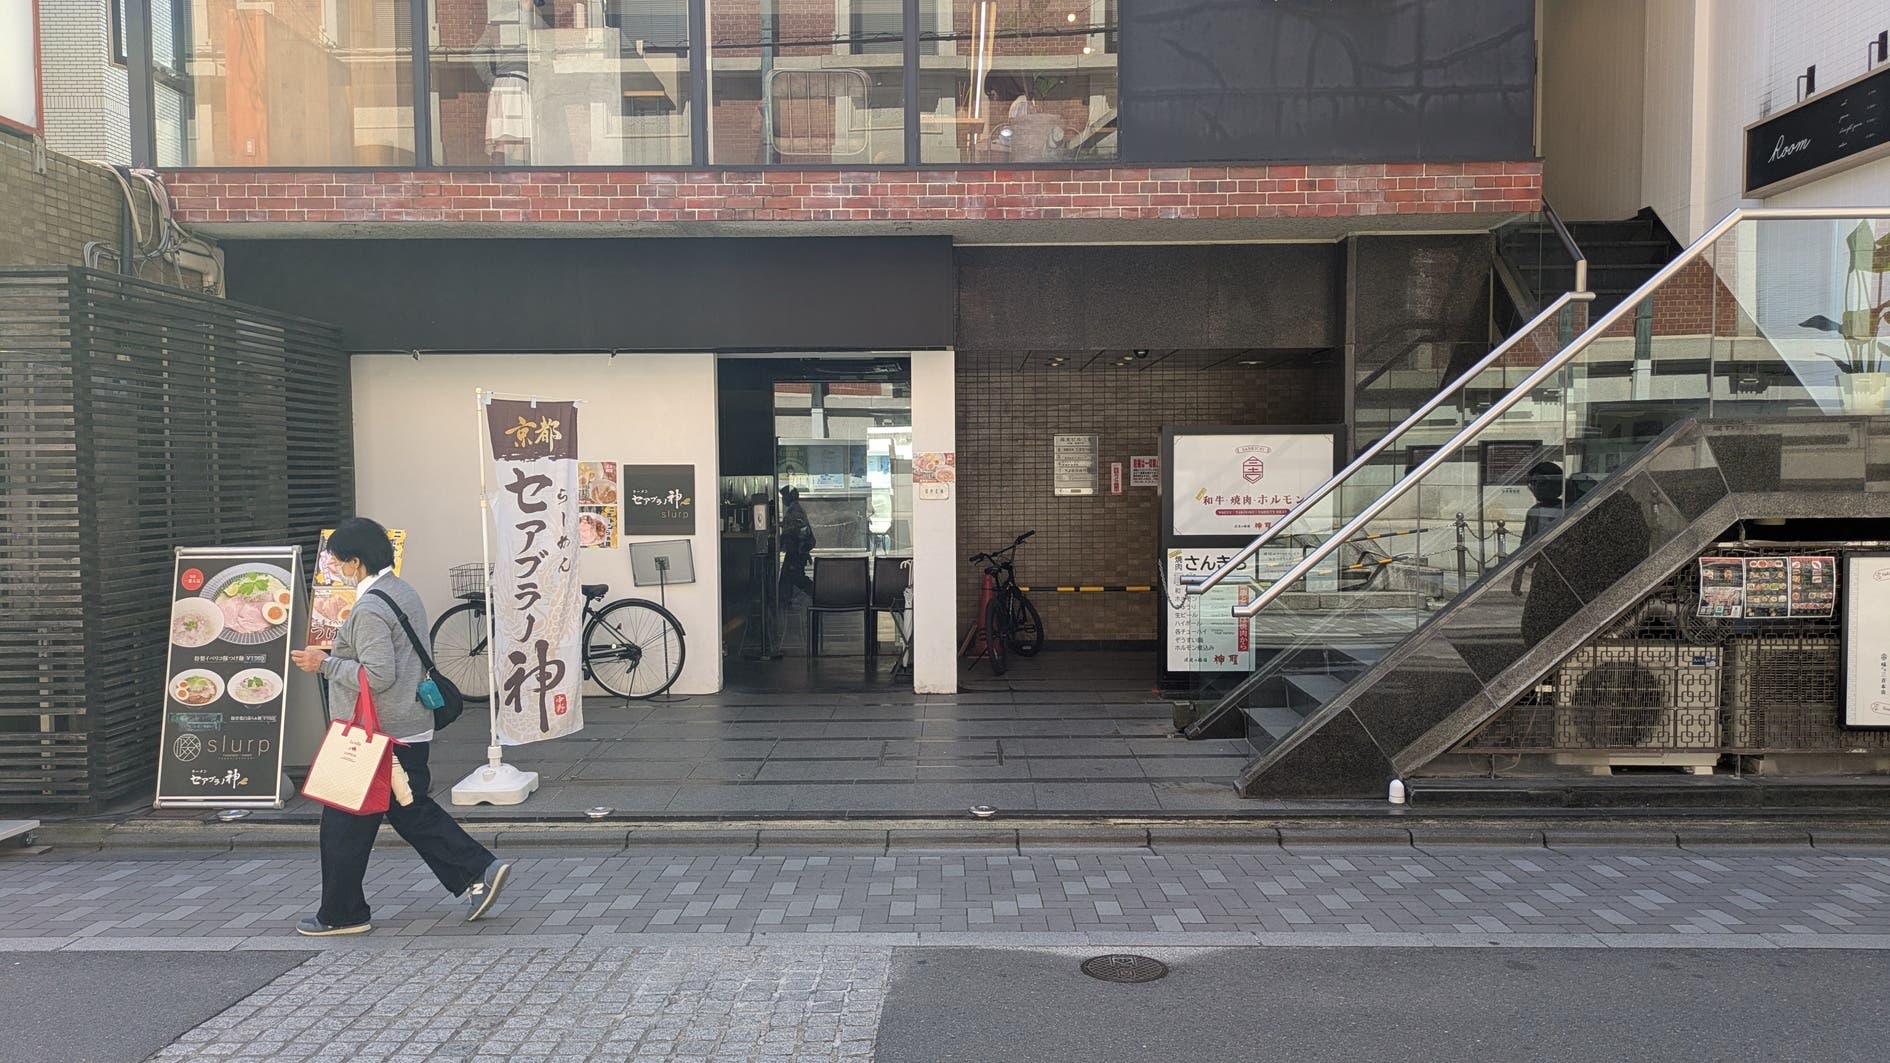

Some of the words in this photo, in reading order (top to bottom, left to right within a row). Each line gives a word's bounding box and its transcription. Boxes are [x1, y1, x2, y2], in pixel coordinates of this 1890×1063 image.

[1768, 134, 1811, 164] Room
[504, 415, 565, 454] 京都
[556, 487, 573, 572] らーめん
[661, 510, 689, 520] slurp
[503, 466, 568, 734] セアブラノ神
[207, 735, 270, 757] slurp
